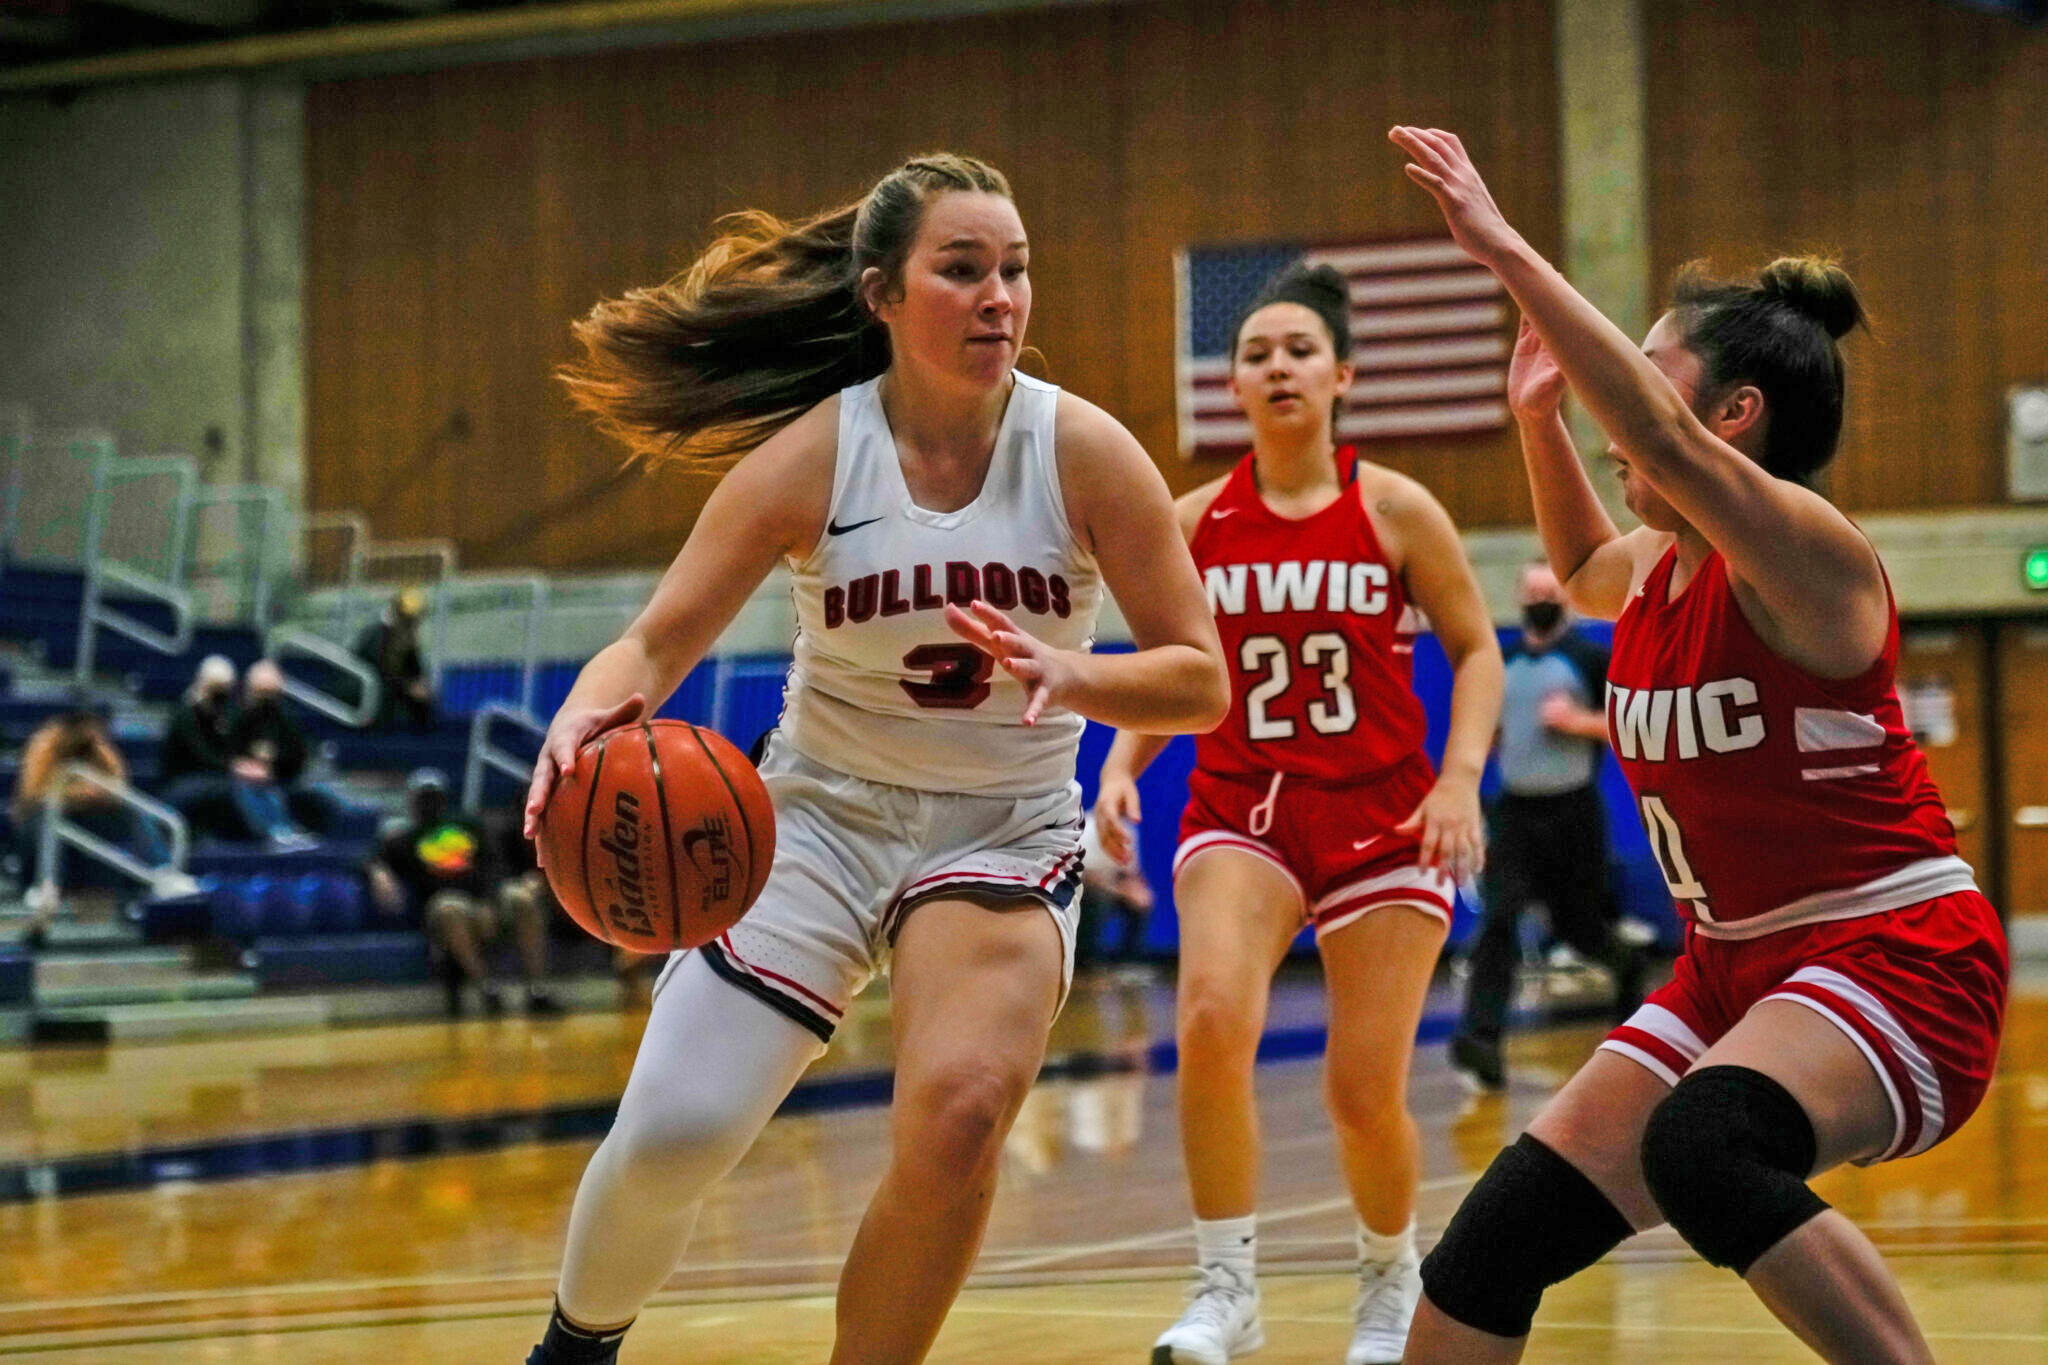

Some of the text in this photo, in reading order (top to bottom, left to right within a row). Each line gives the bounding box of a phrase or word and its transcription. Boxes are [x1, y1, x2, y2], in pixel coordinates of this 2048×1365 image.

[824, 561, 1071, 629] BULLDOGS
[1203, 560, 1389, 616] NWIC
[1240, 632, 1358, 740] 23
[600, 790, 657, 938] Baden
[704, 816, 730, 901] ELITE
[1640, 796, 1714, 923] 4
